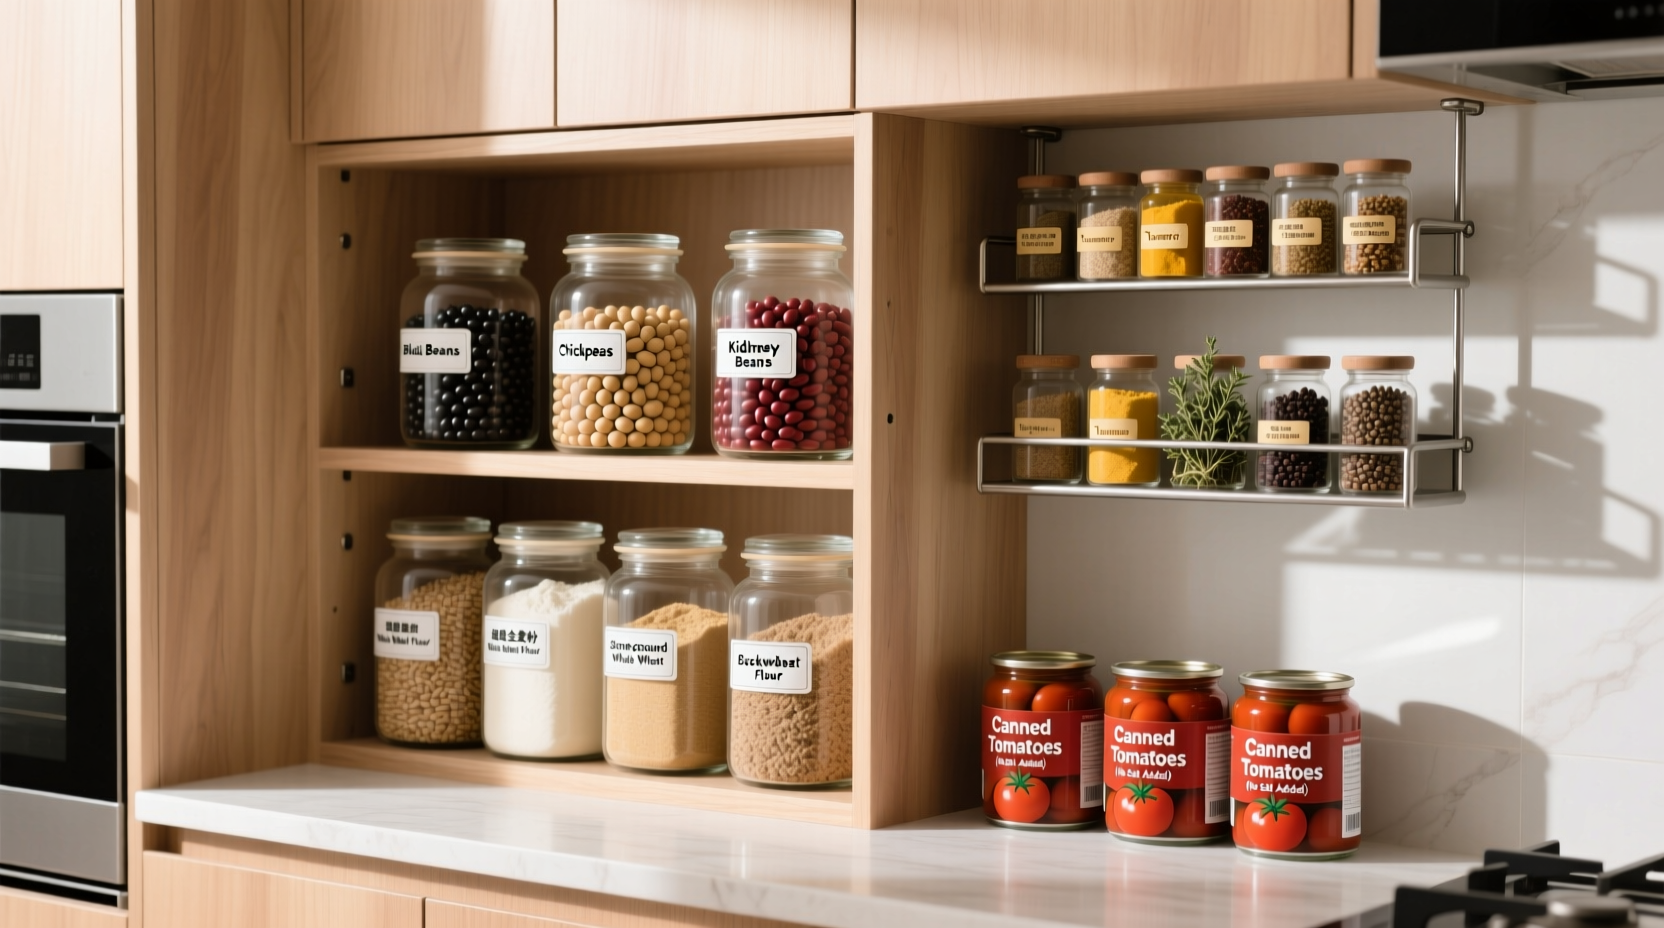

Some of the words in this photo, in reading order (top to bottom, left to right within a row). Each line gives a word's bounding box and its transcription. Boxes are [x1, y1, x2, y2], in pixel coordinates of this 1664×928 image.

[425, 343, 460, 356] Beans
[558, 343, 614, 361] Chickpeas
[735, 355, 773, 368] Beans
[991, 715, 1051, 736] Canned
[1114, 725, 1175, 747] Canned
[987, 734, 1062, 755] Tomatoes
[1245, 737, 1312, 760] Canned
[1110, 744, 1187, 767] Tomatoes
[1240, 757, 1323, 781] Tomatoes
